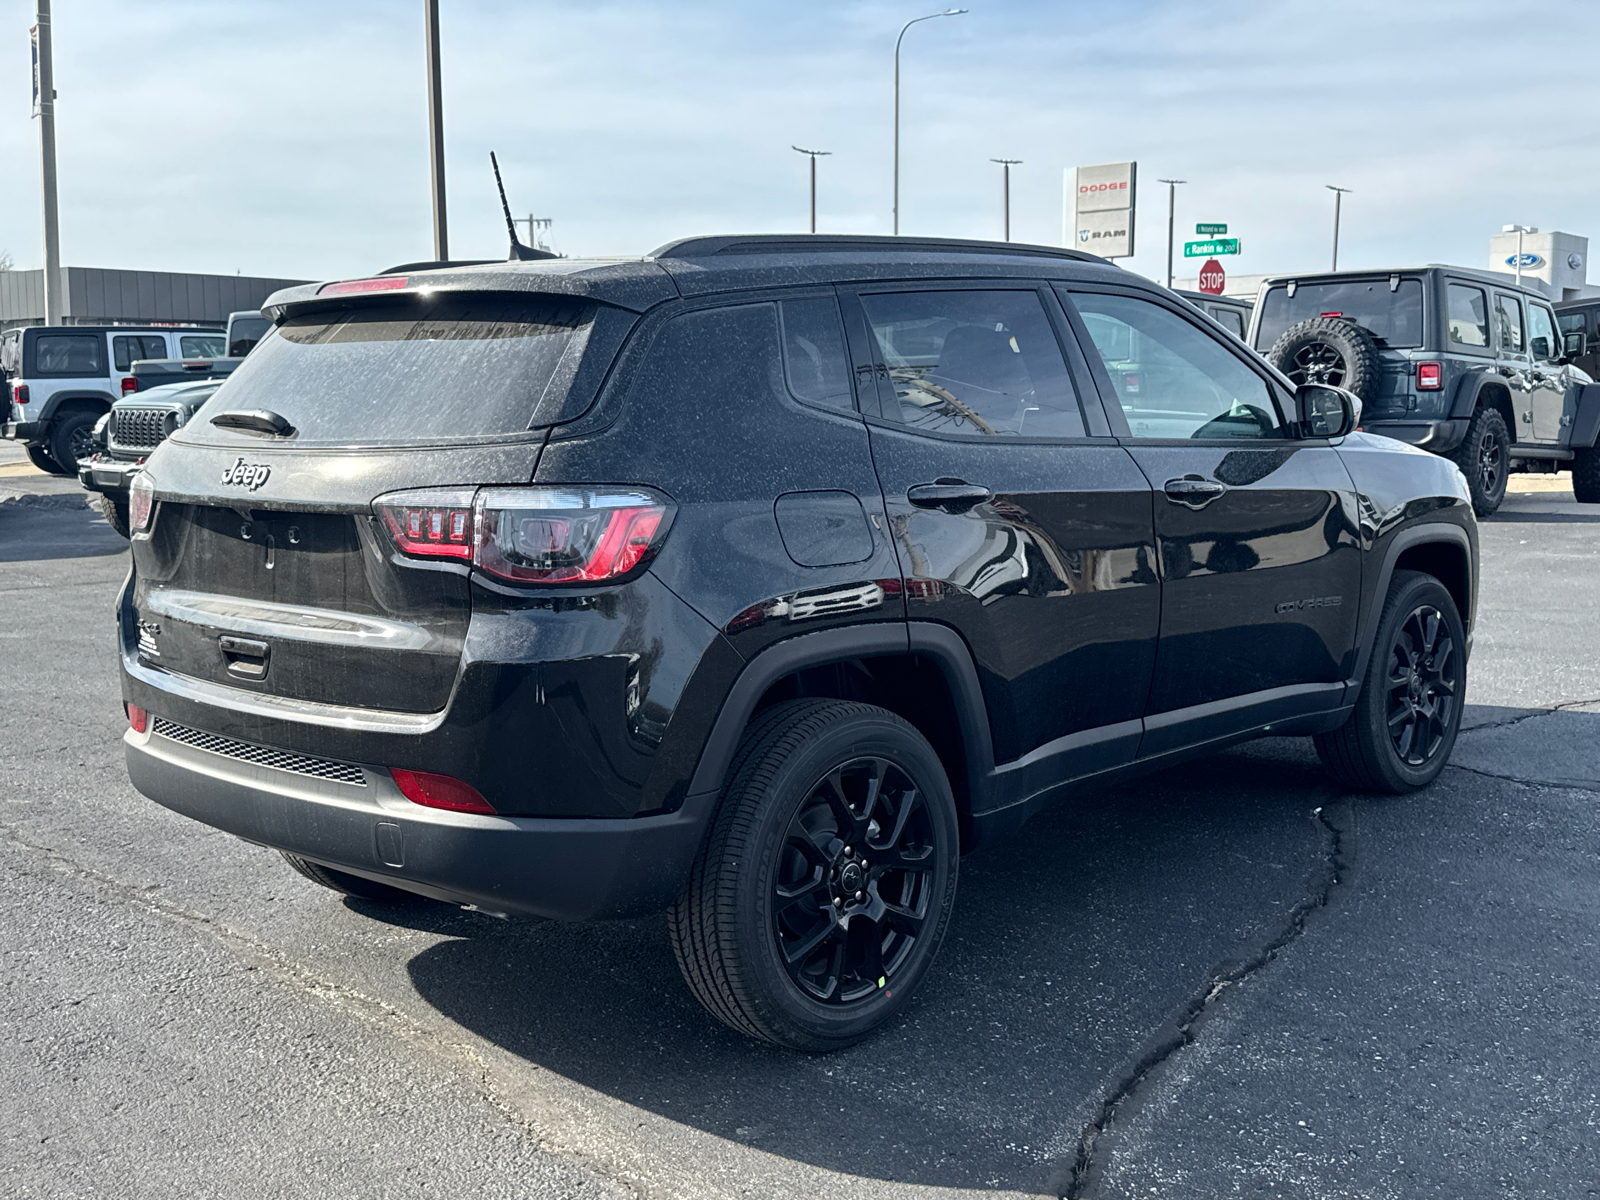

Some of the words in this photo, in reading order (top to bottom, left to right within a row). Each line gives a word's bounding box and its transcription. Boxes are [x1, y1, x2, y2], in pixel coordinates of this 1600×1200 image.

[1080, 182, 1127, 193] DODGE
[1092, 230, 1126, 238] RAM
[1192, 244, 1214, 254] Rankin
[1225, 244, 1235, 252] 200
[1512, 255, 1533, 265] Ford
[1200, 273, 1224, 289] STOP
[220, 458, 271, 492] Jeep
